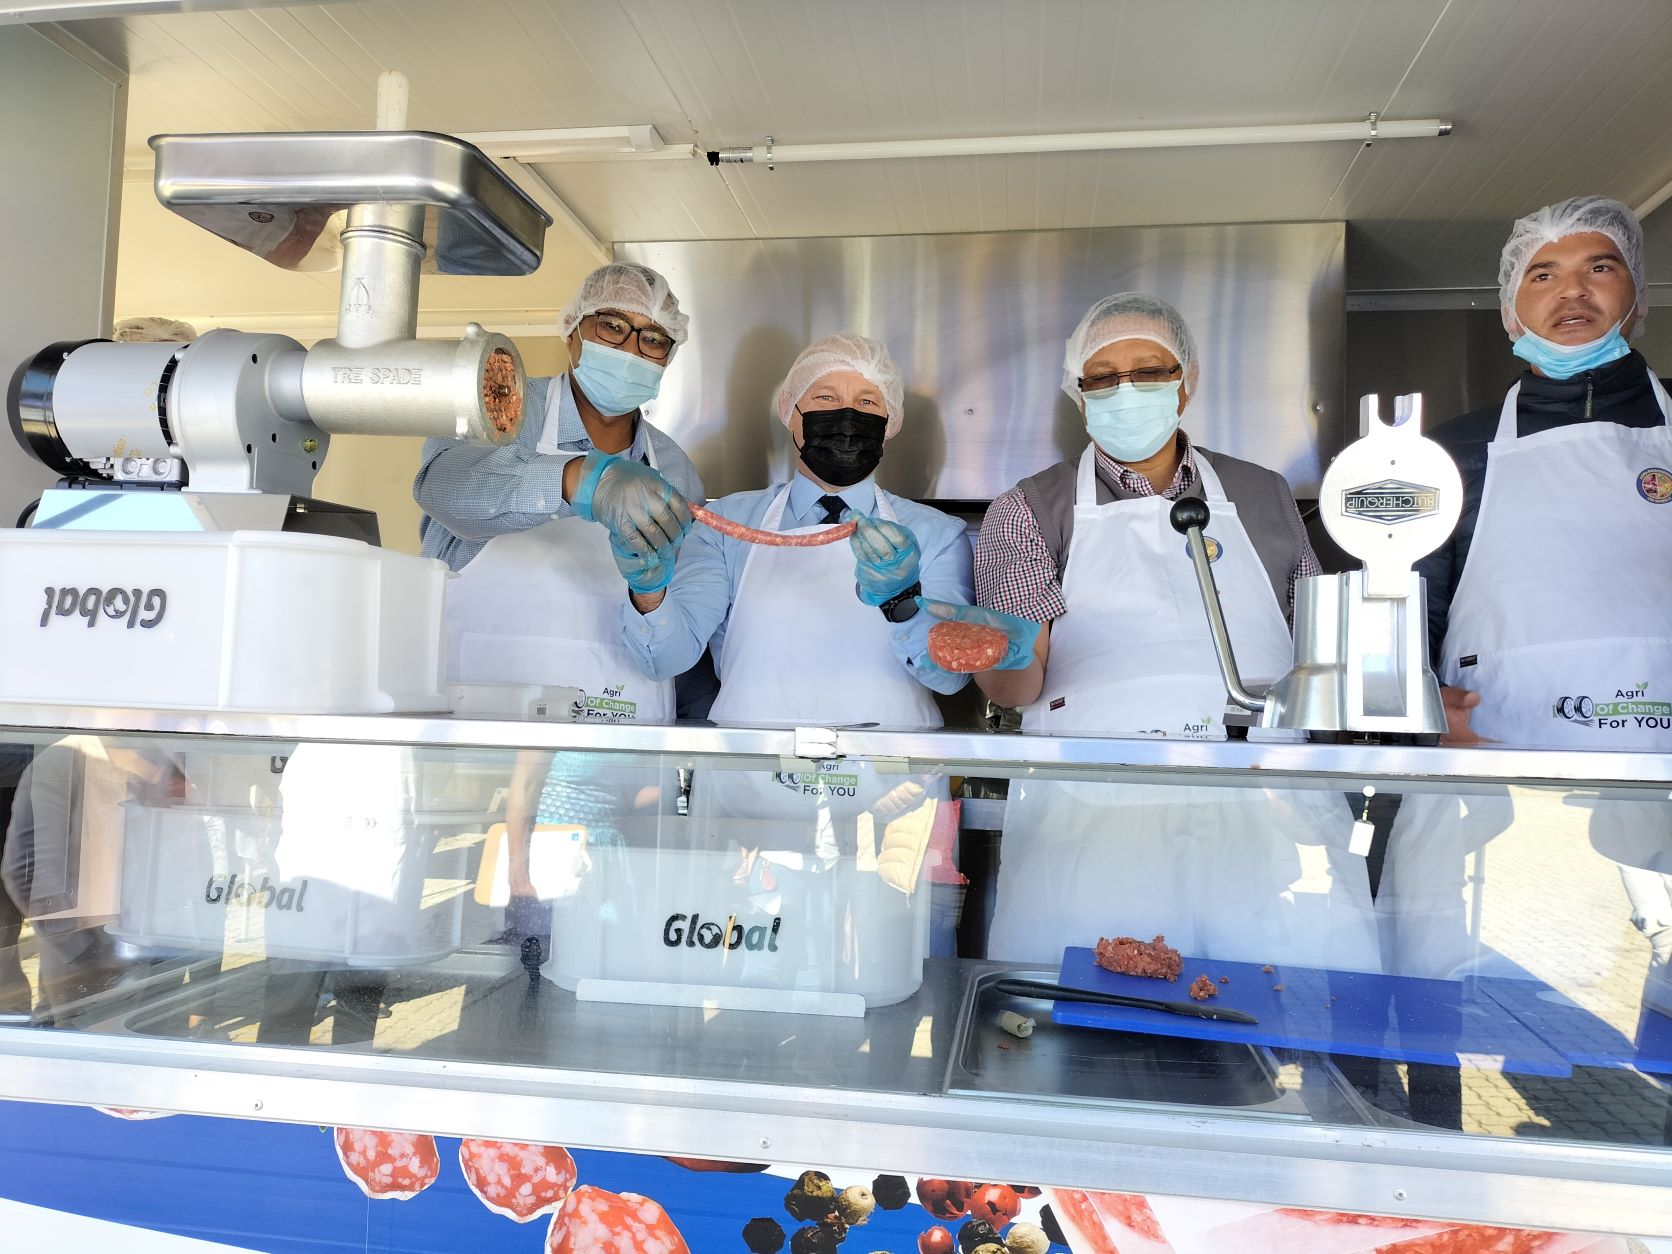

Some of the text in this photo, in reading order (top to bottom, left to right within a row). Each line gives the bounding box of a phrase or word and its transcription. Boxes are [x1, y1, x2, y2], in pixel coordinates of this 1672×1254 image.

[331, 366, 422, 385] TRE SPADE
[1346, 496, 1435, 508] BUTCHERQUIP
[39, 586, 167, 629] Global
[602, 687, 621, 697] Agri
[1615, 690, 1645, 699] Agri
[587, 697, 636, 712] Of Change
[1596, 702, 1670, 715] Of Change
[1183, 723, 1209, 734] Agri
[1598, 716, 1671, 730] For YOU
[803, 773, 815, 783] Of
[828, 786, 857, 798] YOU
[205, 873, 308, 913] Global
[662, 912, 781, 952] Global
